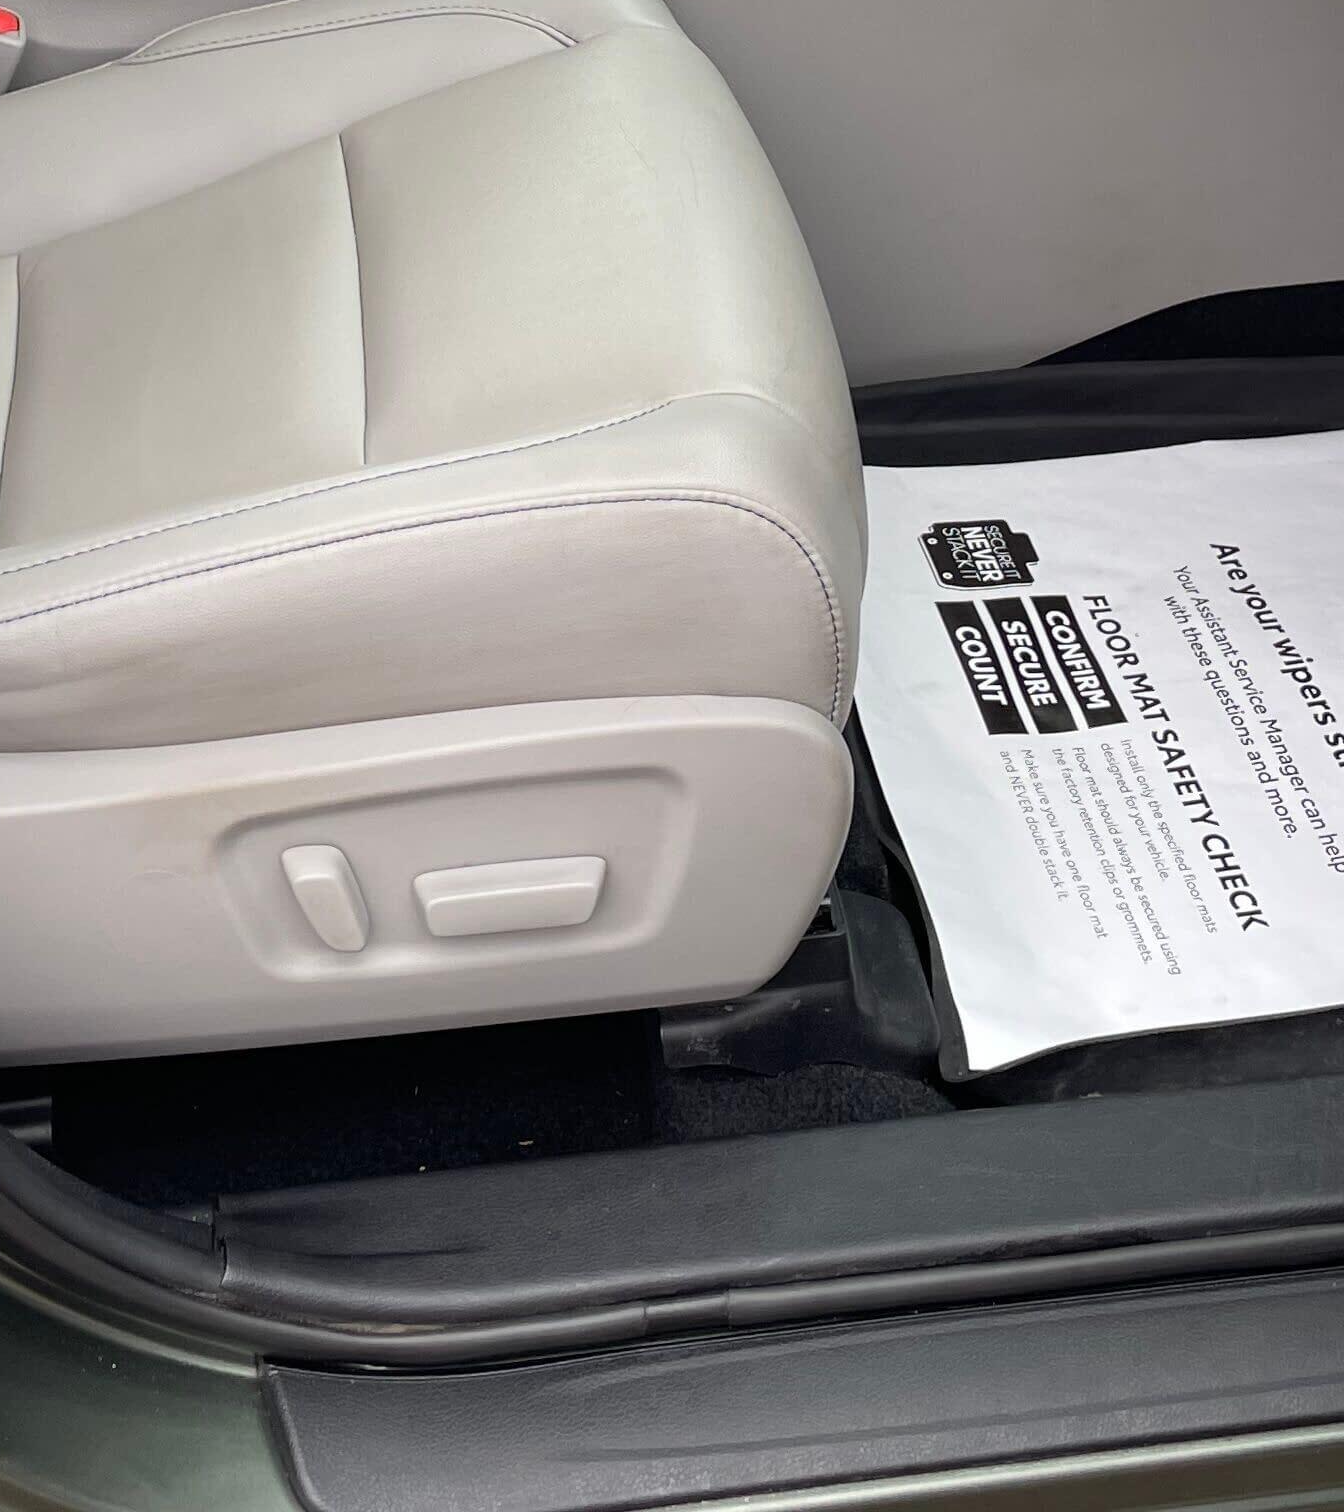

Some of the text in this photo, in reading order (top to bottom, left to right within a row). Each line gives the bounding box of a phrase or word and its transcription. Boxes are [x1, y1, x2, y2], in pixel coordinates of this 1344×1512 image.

[943, 528, 981, 581] STACK IT
[962, 526, 1004, 582] NEVER
[984, 525, 1015, 568] SECURE
[956, 626, 1008, 705] COUNT
[1002, 621, 1058, 706] SECURE
[1046, 610, 1111, 709] CONFIRM
[1164, 596, 1299, 839] with these questions and more.
[1173, 566, 1199, 595] Your
[1191, 597, 1239, 657] Assistant
[1229, 660, 1267, 715] Service
[1260, 719, 1308, 795] Manager
[1302, 799, 1325, 830] can
[1210, 544, 1247, 580] Are
[1230, 584, 1284, 633] your
[1273, 638, 1336, 727] wipers
[1000, 751, 1068, 901] and NEVER double stack it.
[1022, 749, 1107, 938] Make sure you have one floor mat
[1083, 595, 1269, 931] FLOOR MAT SAFETY CHECK
[1100, 743, 1169, 881] designed for your vehicle.
[1121, 739, 1217, 934] Install only the specified floor mats
[1052, 749, 1152, 964] the factory retention clips or grommets.
[1072, 747, 1181, 975] Floor mat should always be secured using
